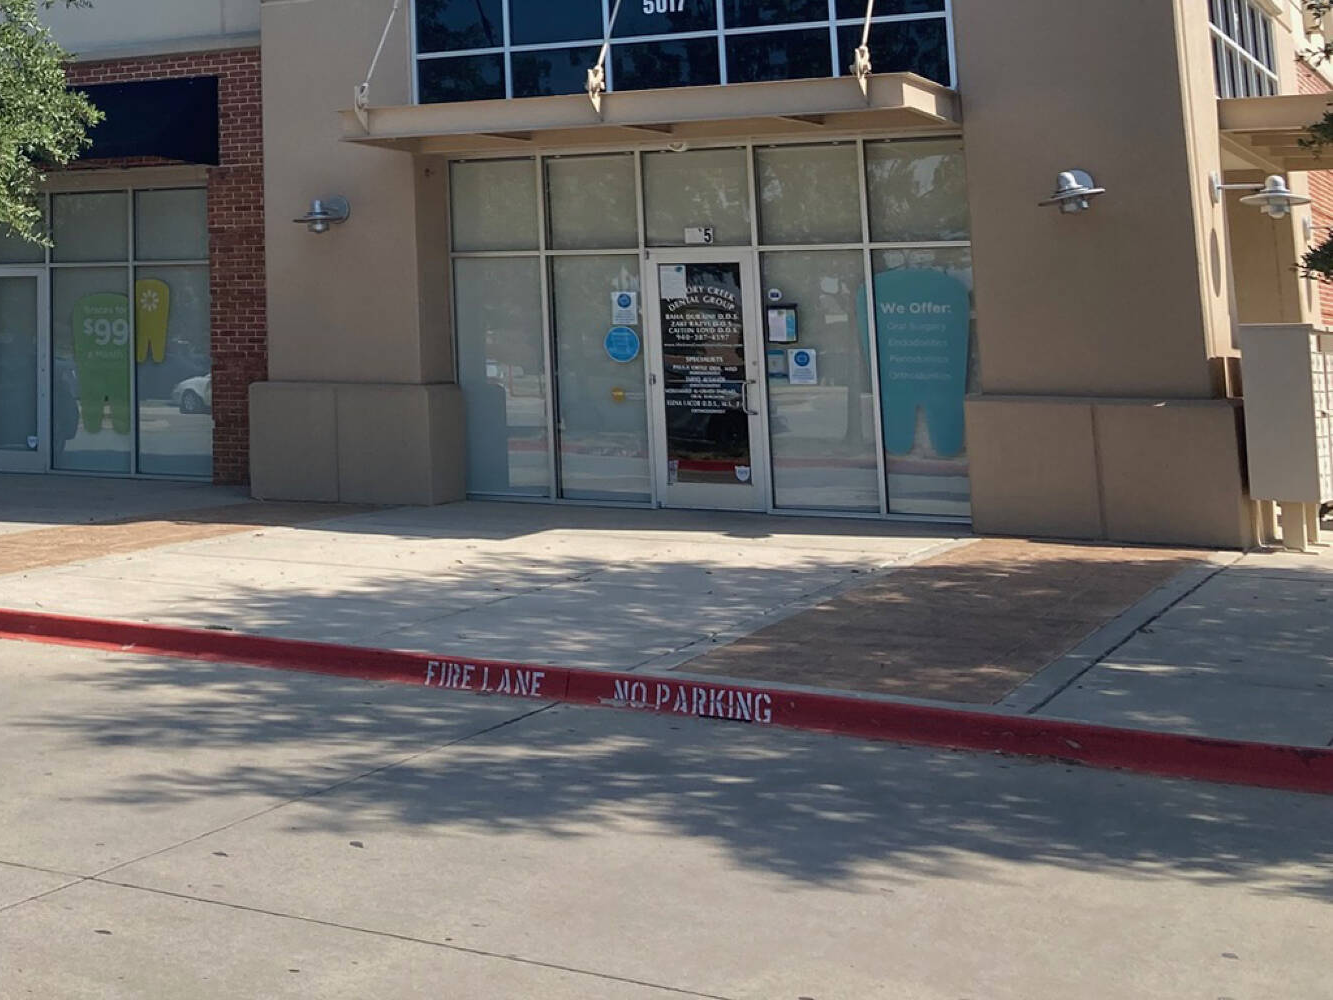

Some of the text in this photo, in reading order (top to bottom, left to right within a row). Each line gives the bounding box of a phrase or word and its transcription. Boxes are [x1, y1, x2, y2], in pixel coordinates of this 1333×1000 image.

[668, 295, 735, 311] DENTAL GROUP
[880, 301, 952, 314] We Offer:
[84, 319, 128, 345] $99
[424, 660, 771, 723] FIRE LANE NO PARKING
